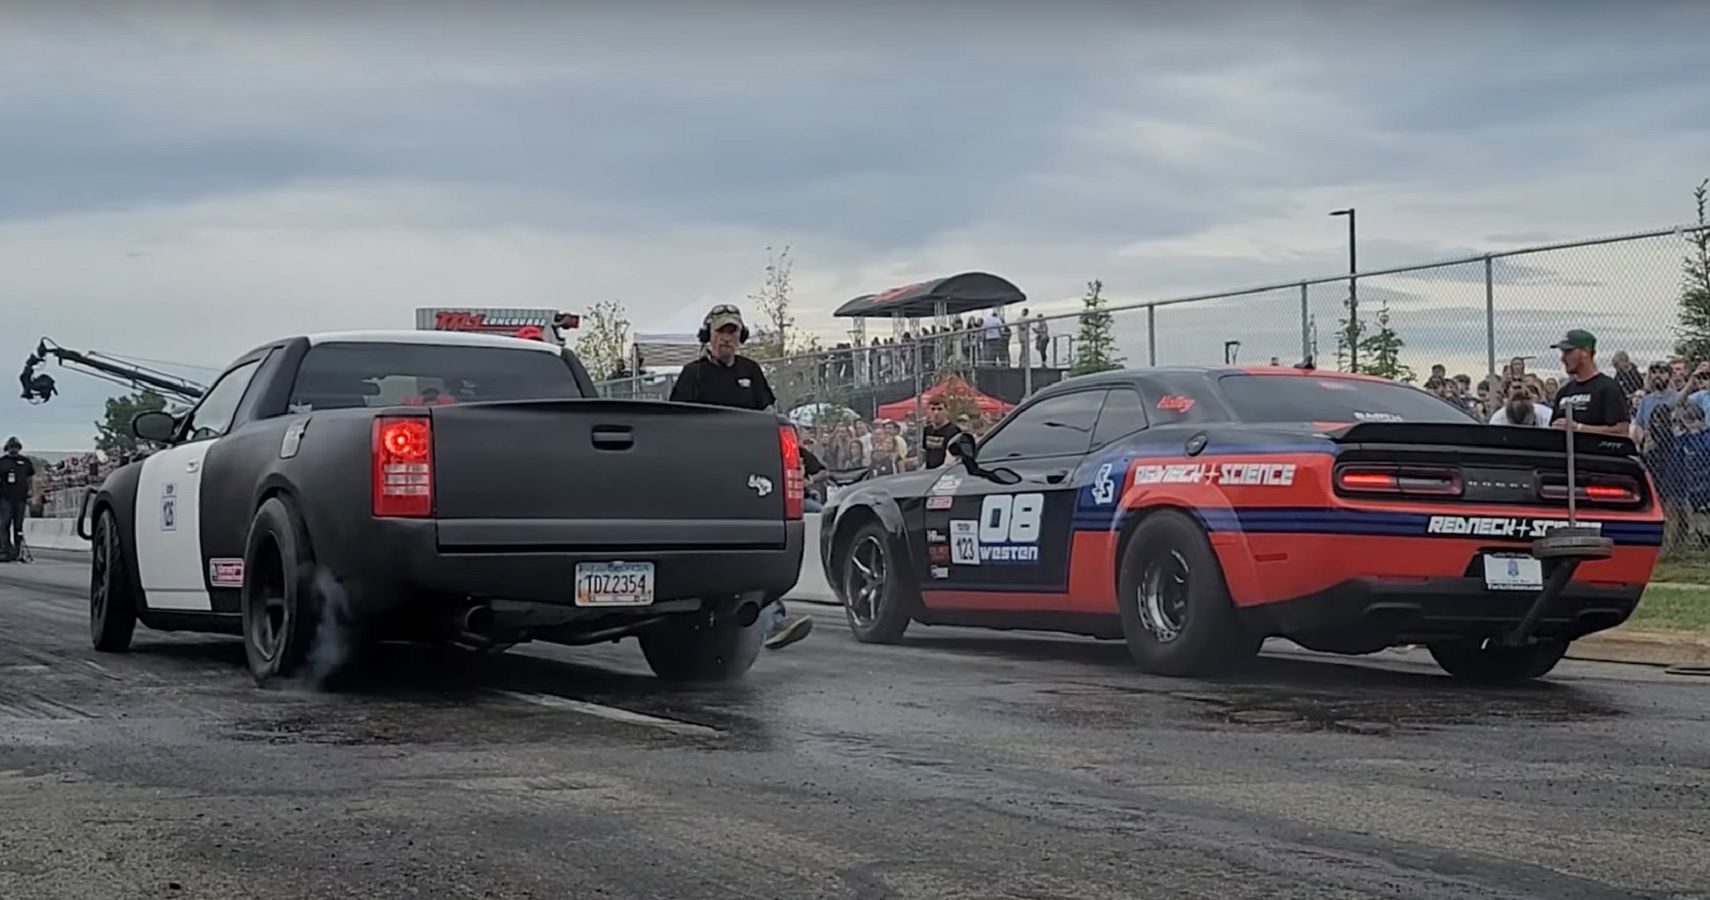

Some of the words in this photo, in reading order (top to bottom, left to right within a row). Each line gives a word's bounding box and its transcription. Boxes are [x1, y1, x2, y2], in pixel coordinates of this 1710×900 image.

[980, 493, 1044, 542] 08
[956, 538, 975, 560] 123
[585, 574, 646, 594] TDZ2354
